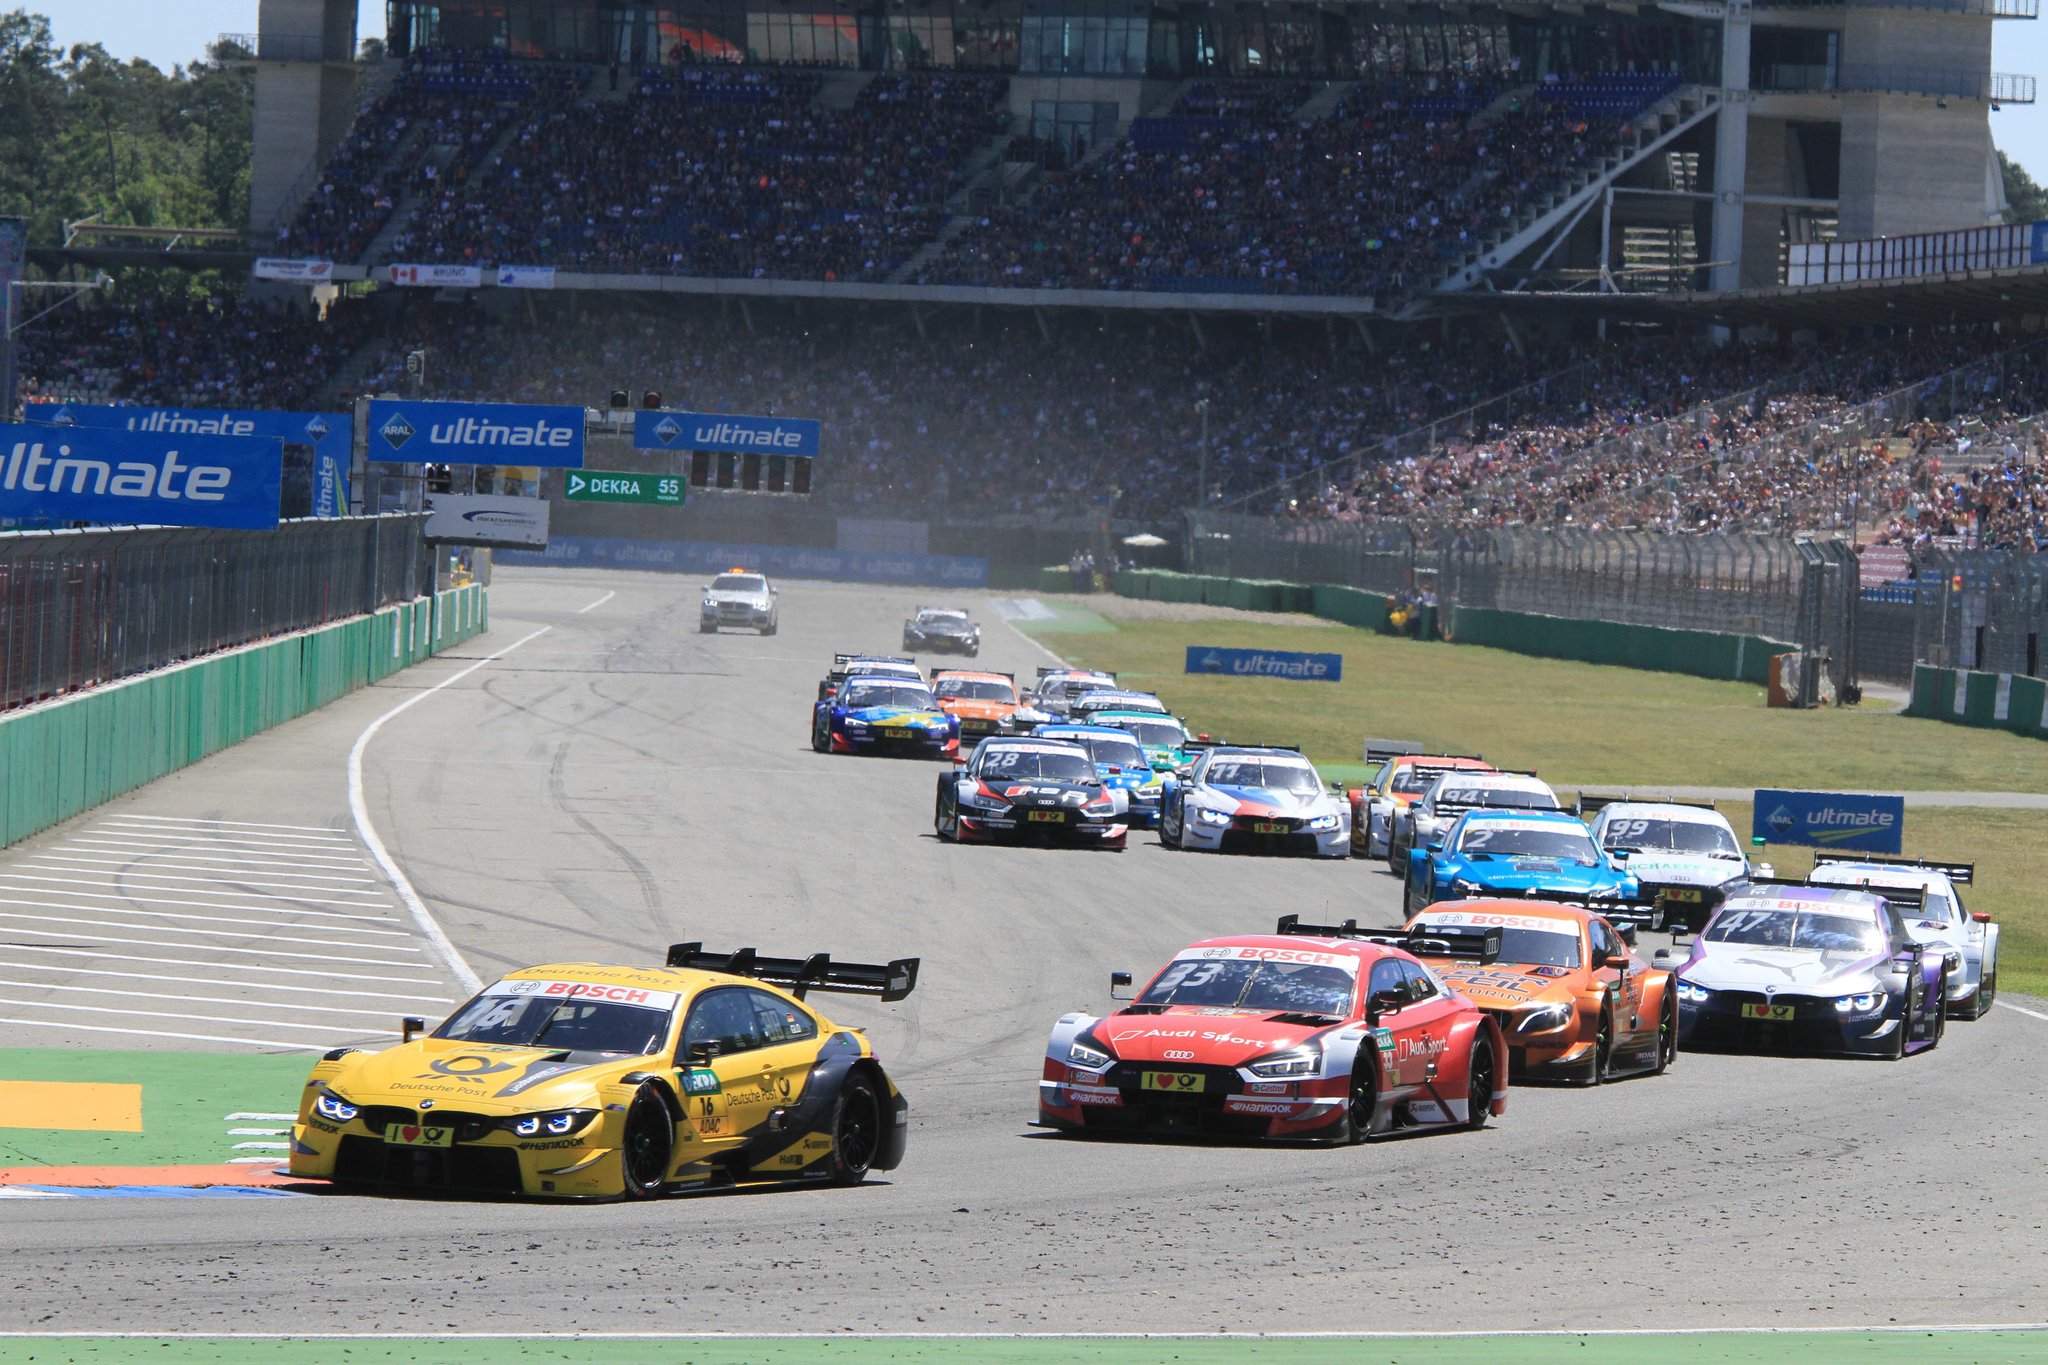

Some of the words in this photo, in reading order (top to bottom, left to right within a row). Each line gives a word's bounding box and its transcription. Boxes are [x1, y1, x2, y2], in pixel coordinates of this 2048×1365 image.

[127, 411, 255, 436] ultimate
[383, 425, 411, 436] ARAL
[430, 417, 573, 447] ultimate
[656, 425, 679, 434] ARAL
[695, 423, 802, 448] ultimate
[590, 478, 641, 496] DEKRA
[657, 479, 679, 495] 55
[1233, 655, 1328, 676] ultimate
[986, 752, 1019, 767] 28
[1444, 790, 1479, 802] 94
[1769, 816, 1793, 825] ARAL
[1806, 808, 1895, 826] ultimate
[1610, 820, 1649, 836] 99
[1464, 831, 1495, 848] 2
[1470, 915, 1555, 931] BOSCH
[1715, 912, 1774, 933] 47
[1238, 948, 1335, 965] BOSCH
[524, 967, 621, 978] Deutsche
[631, 974, 671, 985] Post
[1157, 962, 1224, 988] 33
[544, 982, 650, 1004] BOSCH
[1440, 975, 1531, 994] FEIL
[1144, 1028, 1197, 1039] Audi
[1201, 1030, 1266, 1048] Sport
[390, 1082, 455, 1094] Deutsche
[457, 1086, 488, 1097] Post
[682, 1074, 718, 1093] DEKRA
[1259, 1084, 1285, 1093] Castrol
[726, 1089, 761, 1107] Deutsche
[762, 1087, 777, 1103] Post
[700, 1097, 714, 1117] 16
[699, 1118, 721, 1134] ADAC
